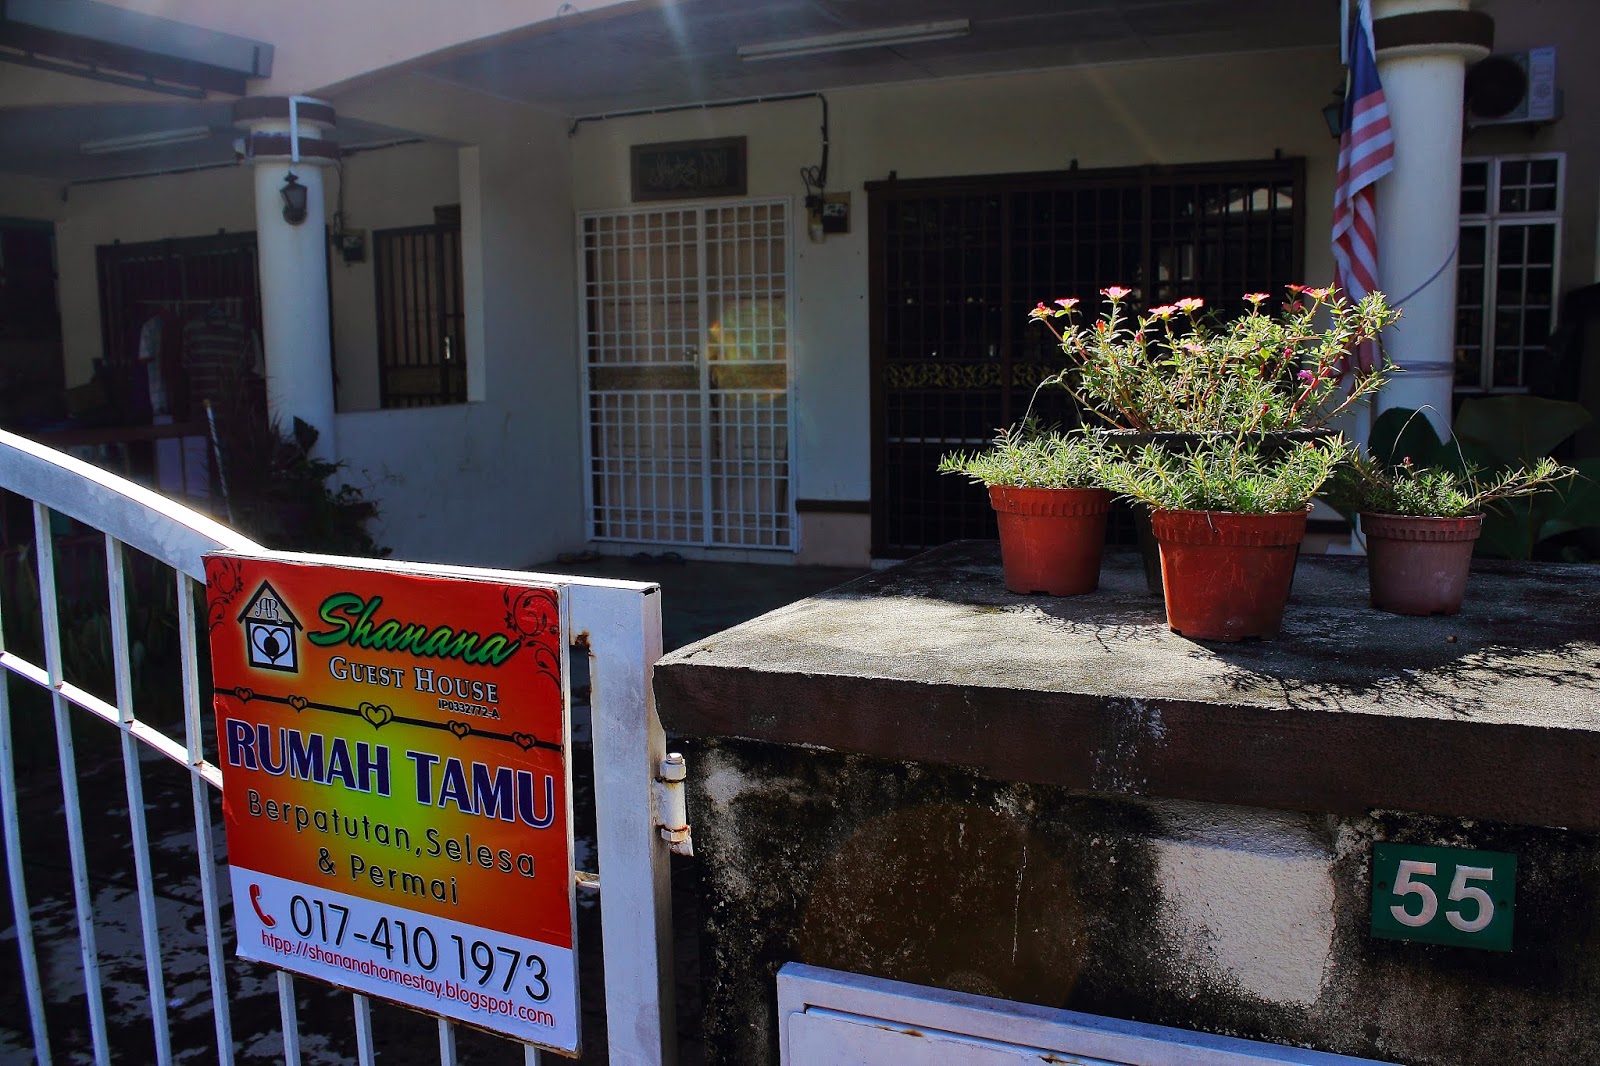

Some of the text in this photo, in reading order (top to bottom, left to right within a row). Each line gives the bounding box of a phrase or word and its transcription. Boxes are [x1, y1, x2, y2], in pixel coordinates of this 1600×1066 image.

[307, 592, 524, 667] Shanana
[329, 656, 499, 704] GUEST HOUSE
[438, 698, 500, 720] IP0332772-A
[225, 717, 555, 828] RUMAH TAMU
[317, 847, 459, 905] & Permai
[1390, 860, 1494, 933] 55
[261, 929, 555, 1027] htpp://shananahomestay.blogspot.com
[289, 894, 551, 1002] 017-410 1973
